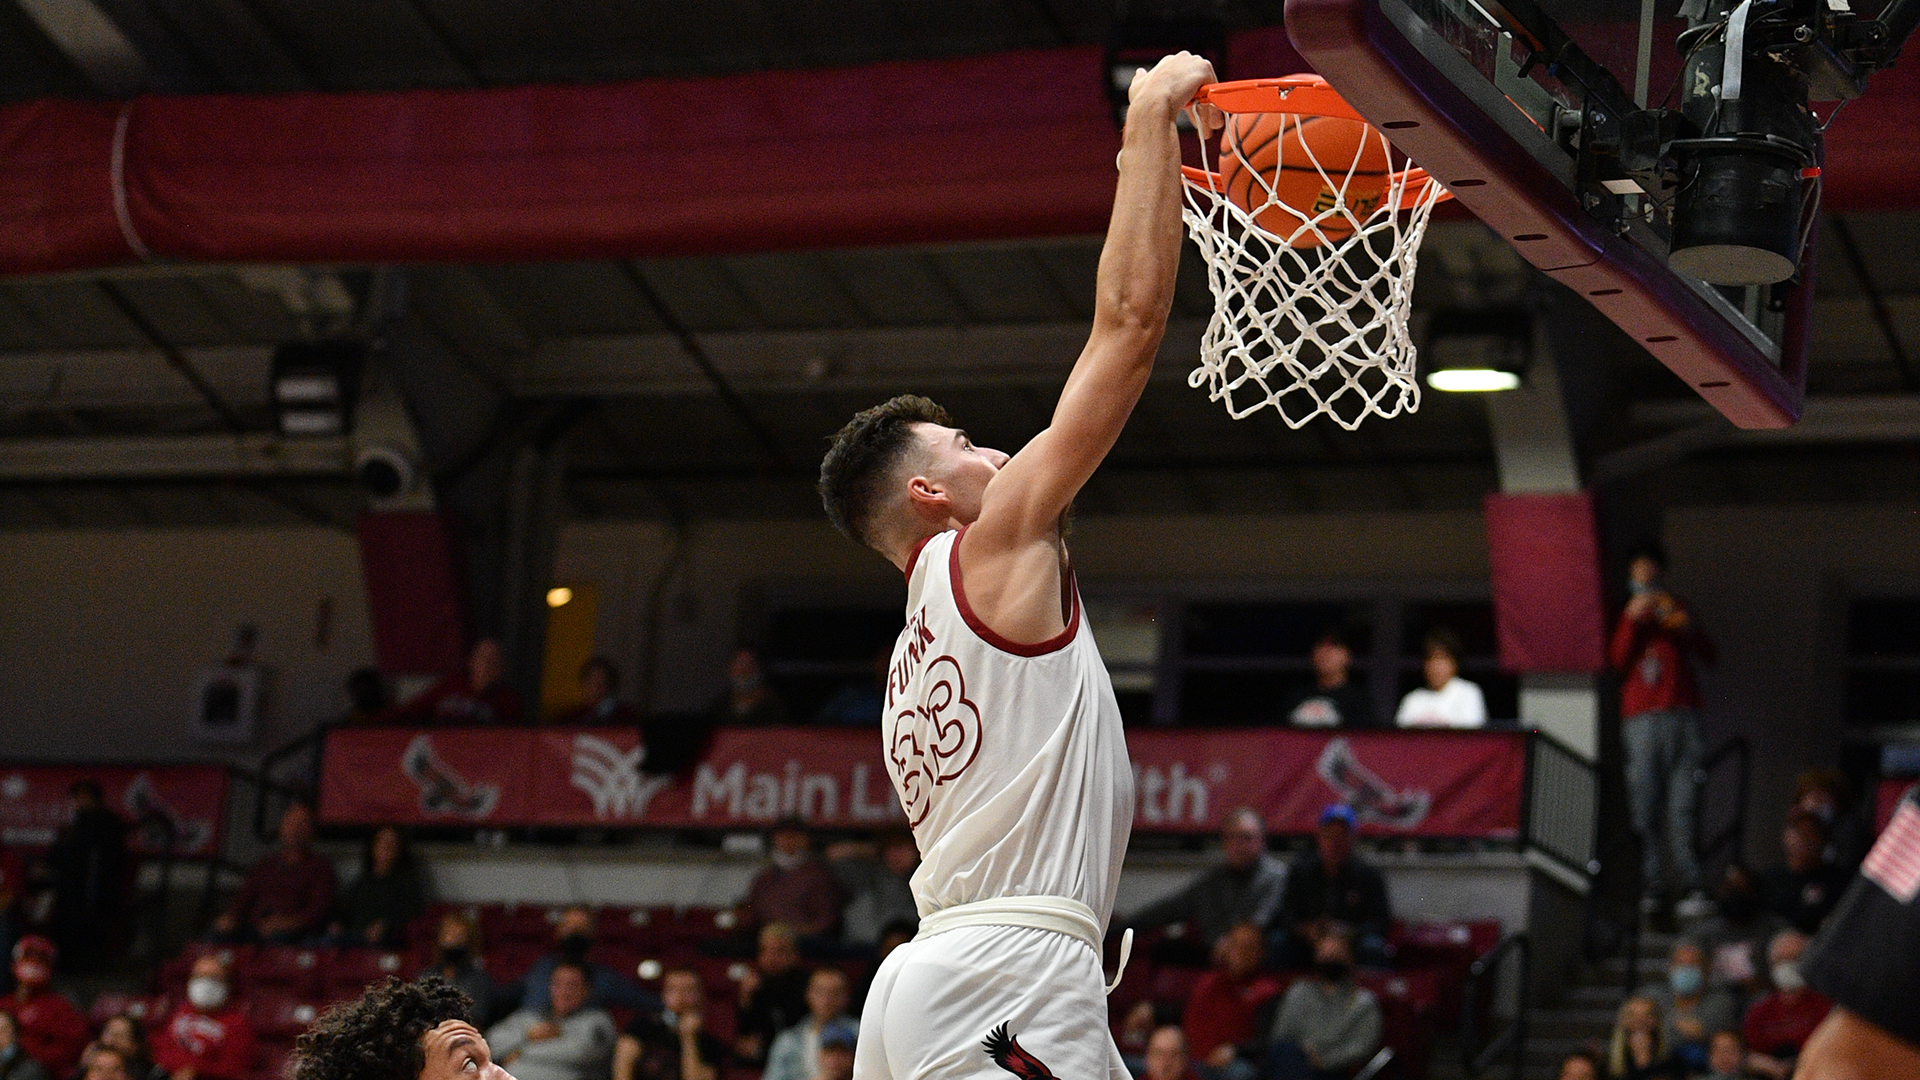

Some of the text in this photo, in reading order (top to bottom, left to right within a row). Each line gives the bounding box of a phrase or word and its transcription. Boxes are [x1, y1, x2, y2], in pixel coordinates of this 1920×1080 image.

[888, 604, 936, 710] FUNK
[692, 761, 839, 820] Main
[891, 655, 983, 830] 33
